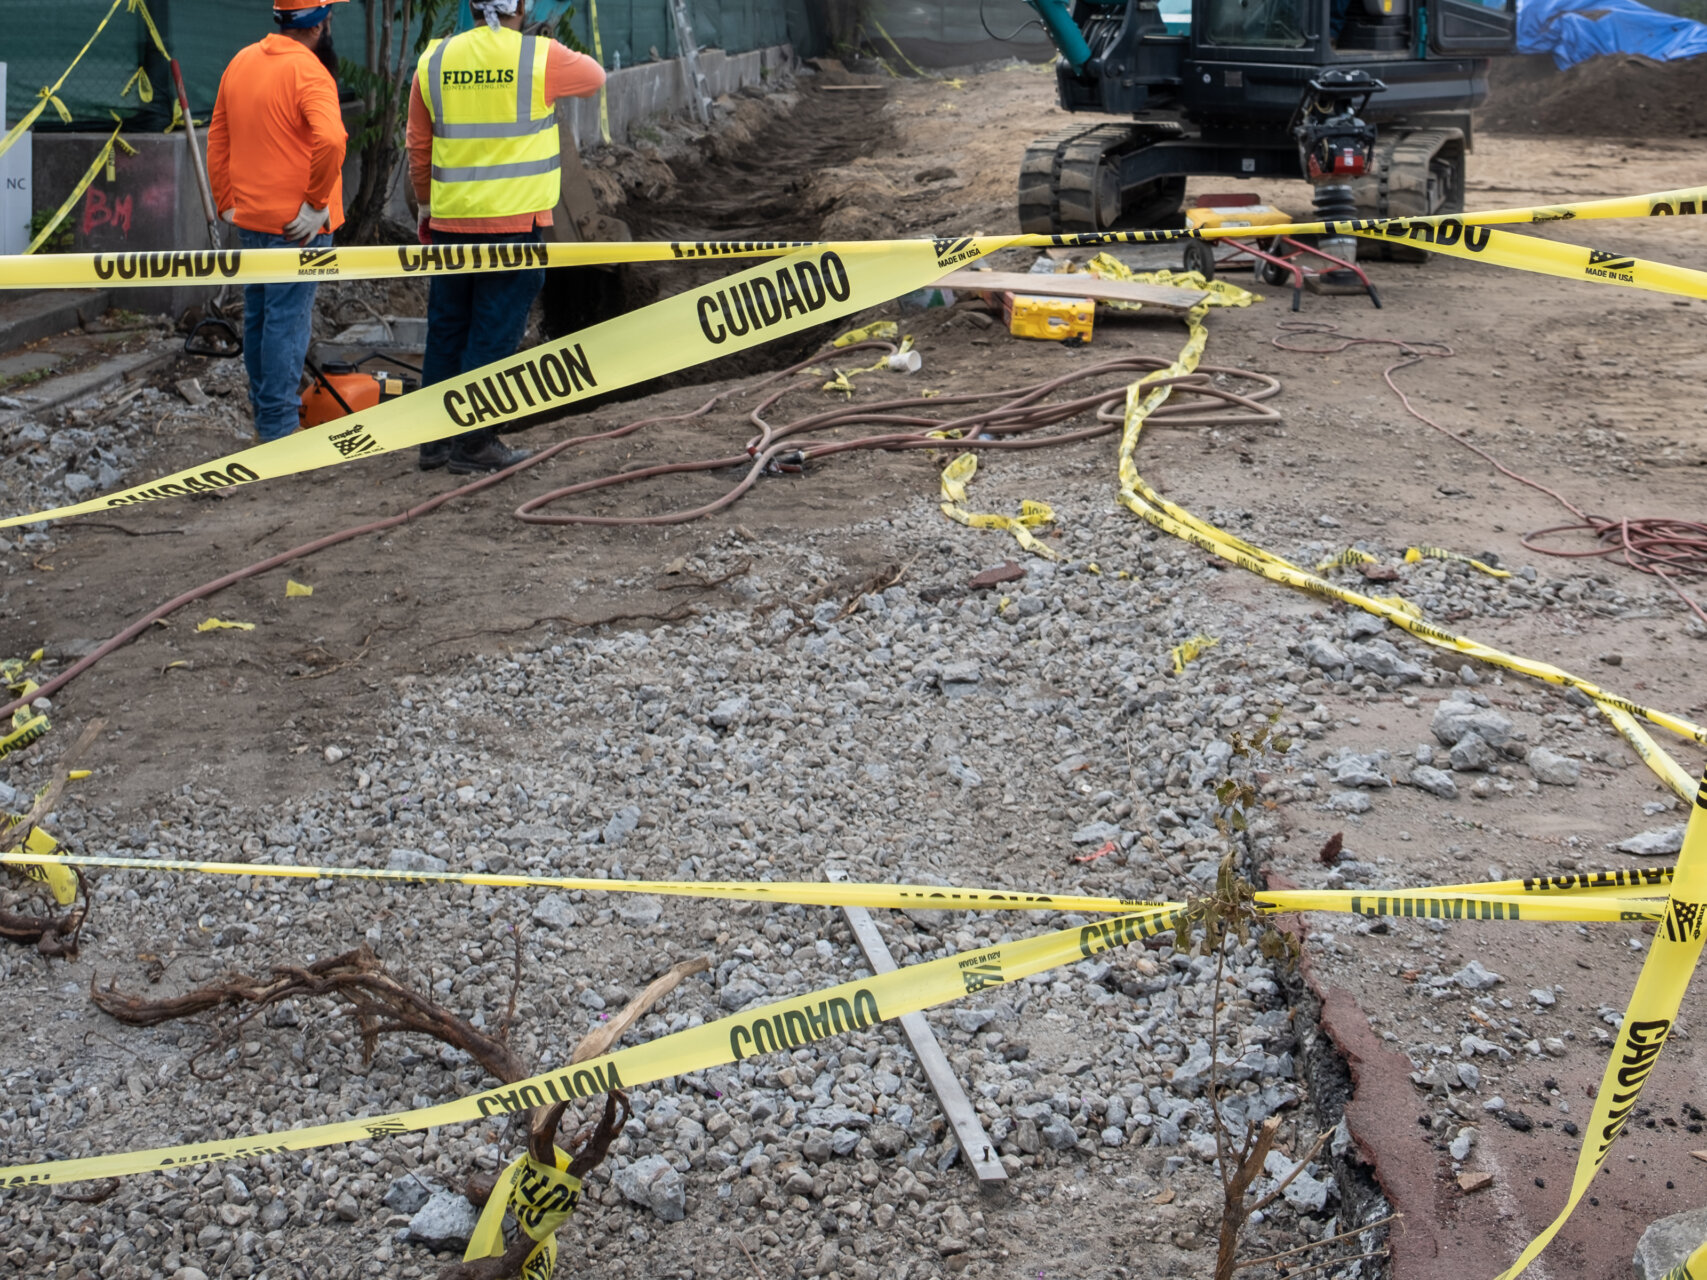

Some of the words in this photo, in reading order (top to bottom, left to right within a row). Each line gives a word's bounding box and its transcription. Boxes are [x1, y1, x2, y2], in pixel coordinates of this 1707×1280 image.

[443, 69, 514, 84] FIDELIS
[938, 256, 958, 268] MADE
[958, 253, 966, 261] IN
[966, 248, 981, 258] USA
[1585, 267, 1607, 278] MADE
[1619, 273, 1634, 283] USA
[696, 251, 850, 344] CUIDADO
[443, 344, 598, 427] CAUTION
